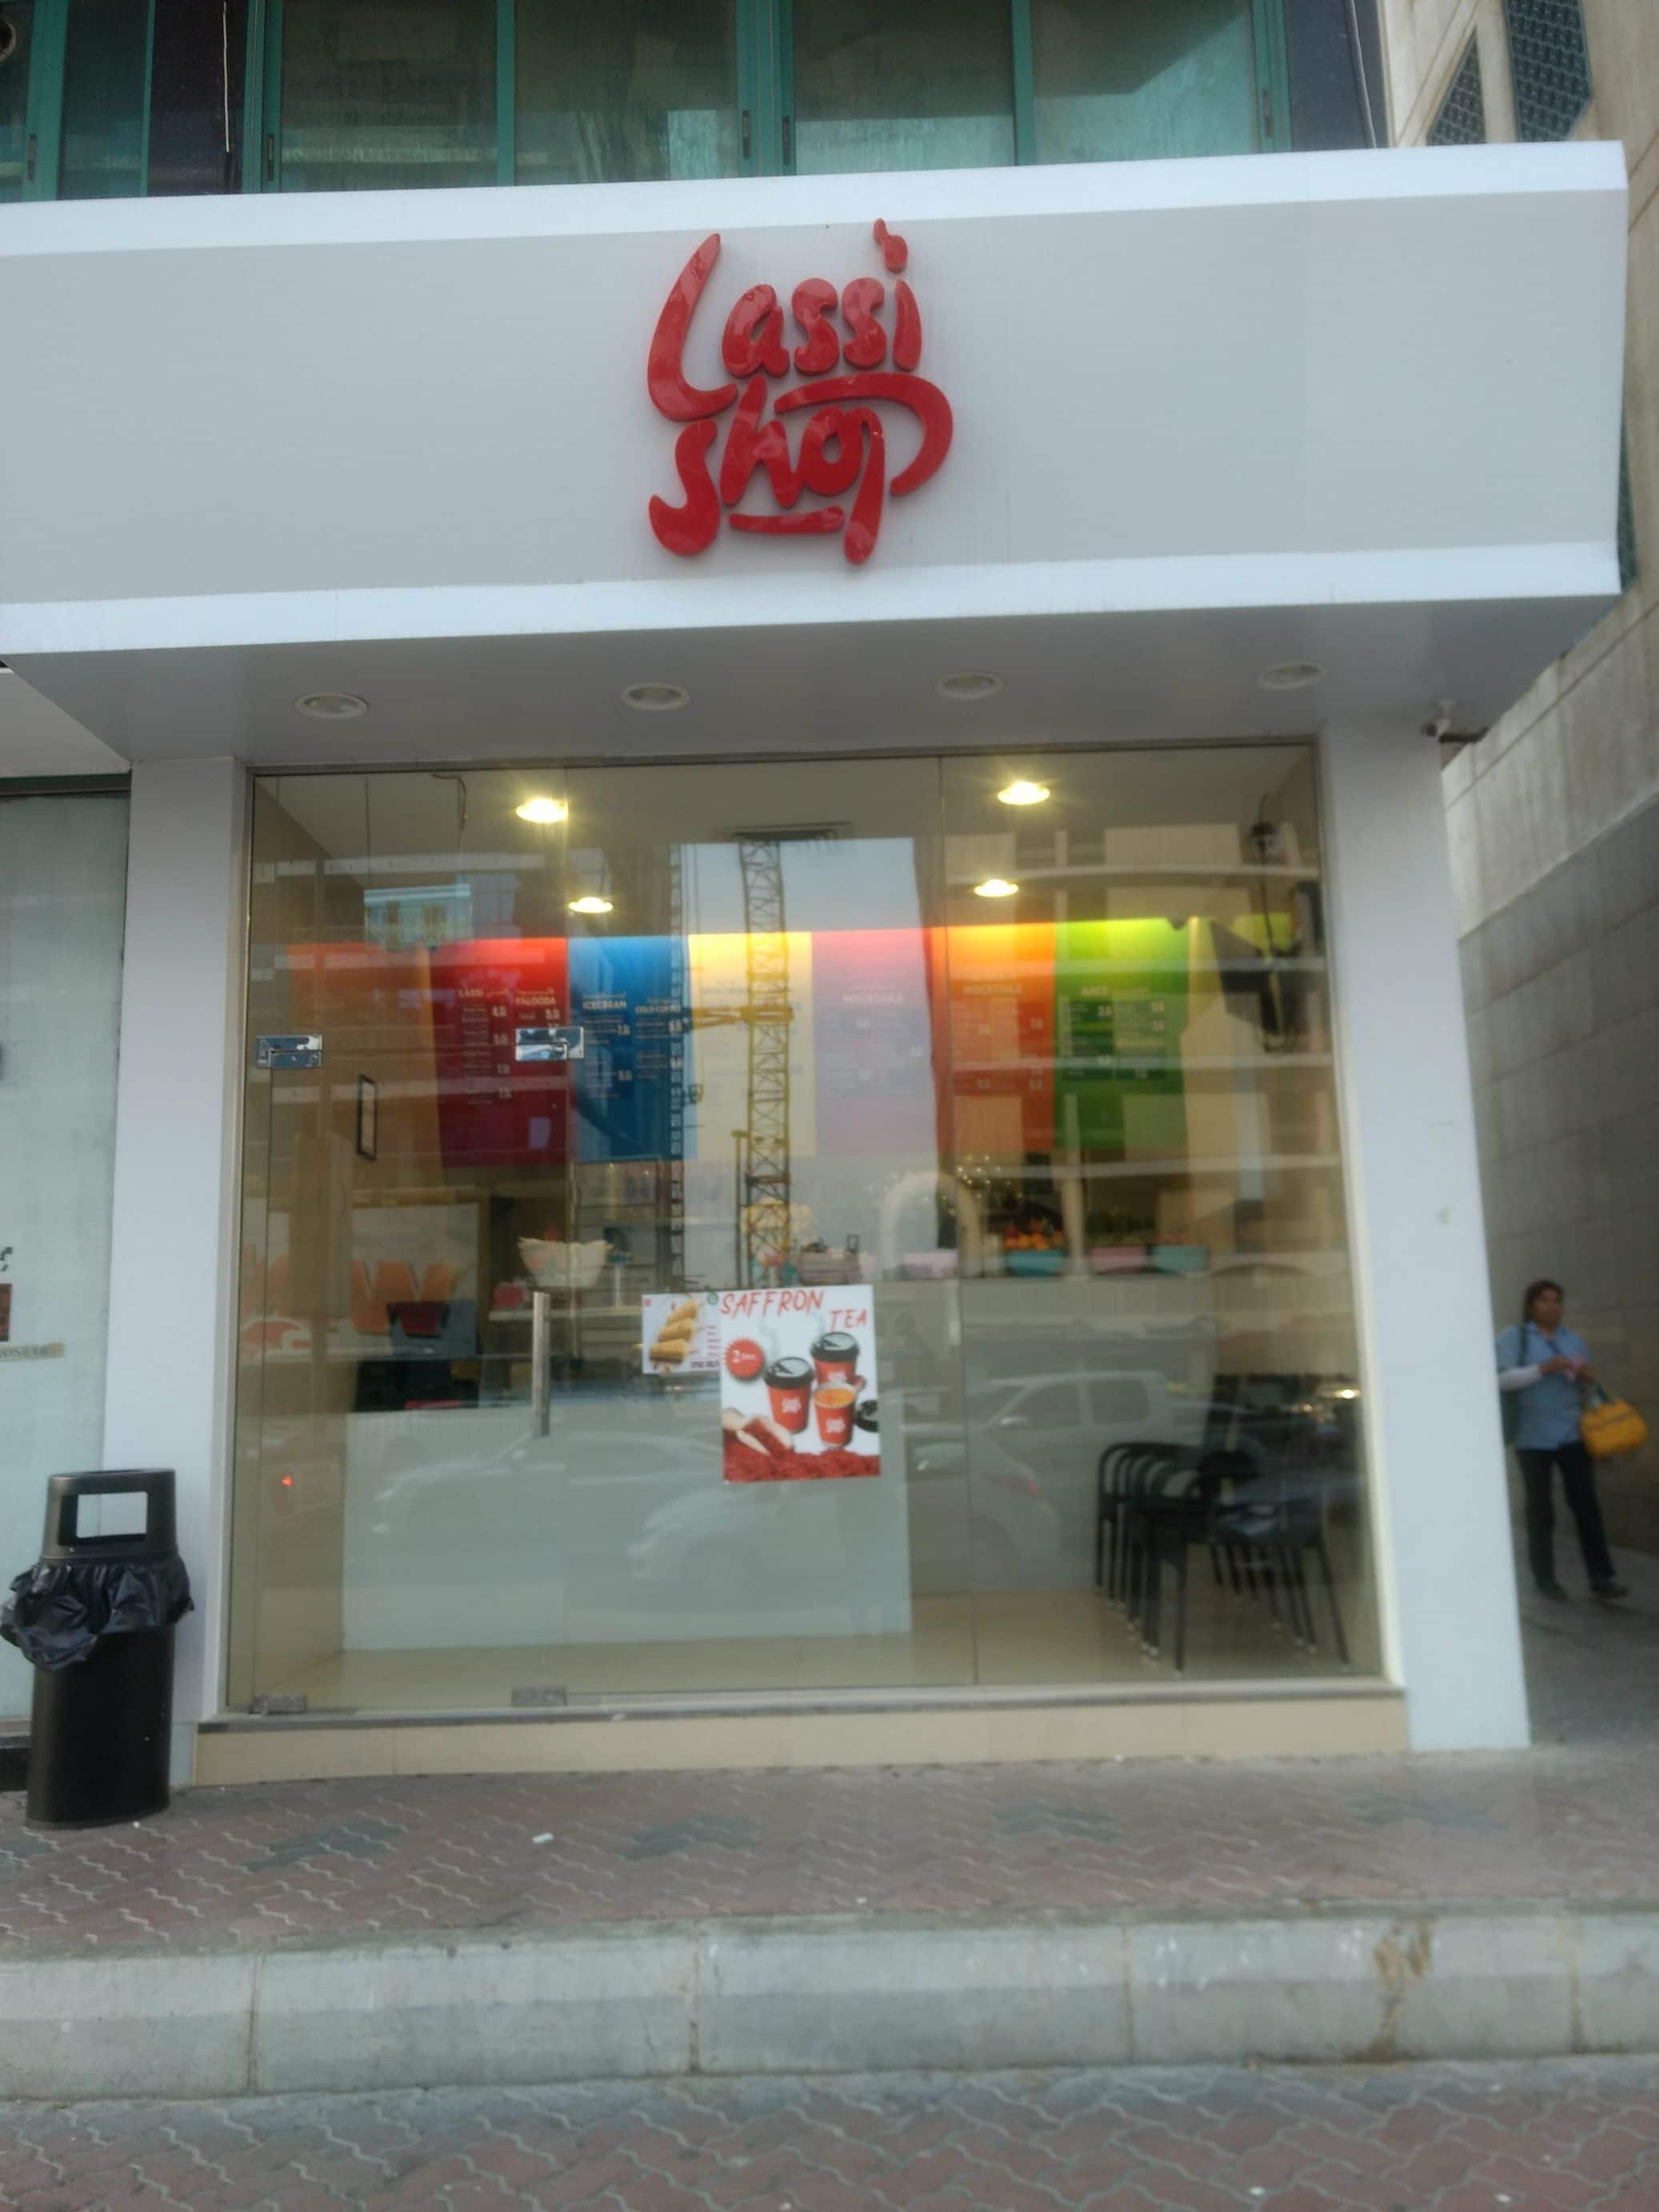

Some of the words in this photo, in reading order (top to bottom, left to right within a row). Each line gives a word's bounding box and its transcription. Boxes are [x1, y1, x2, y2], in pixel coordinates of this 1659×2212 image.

[647, 217, 923, 422] Lassi
[721, 1289, 824, 1318] SAFFRON
[830, 1309, 868, 1332] TEA
